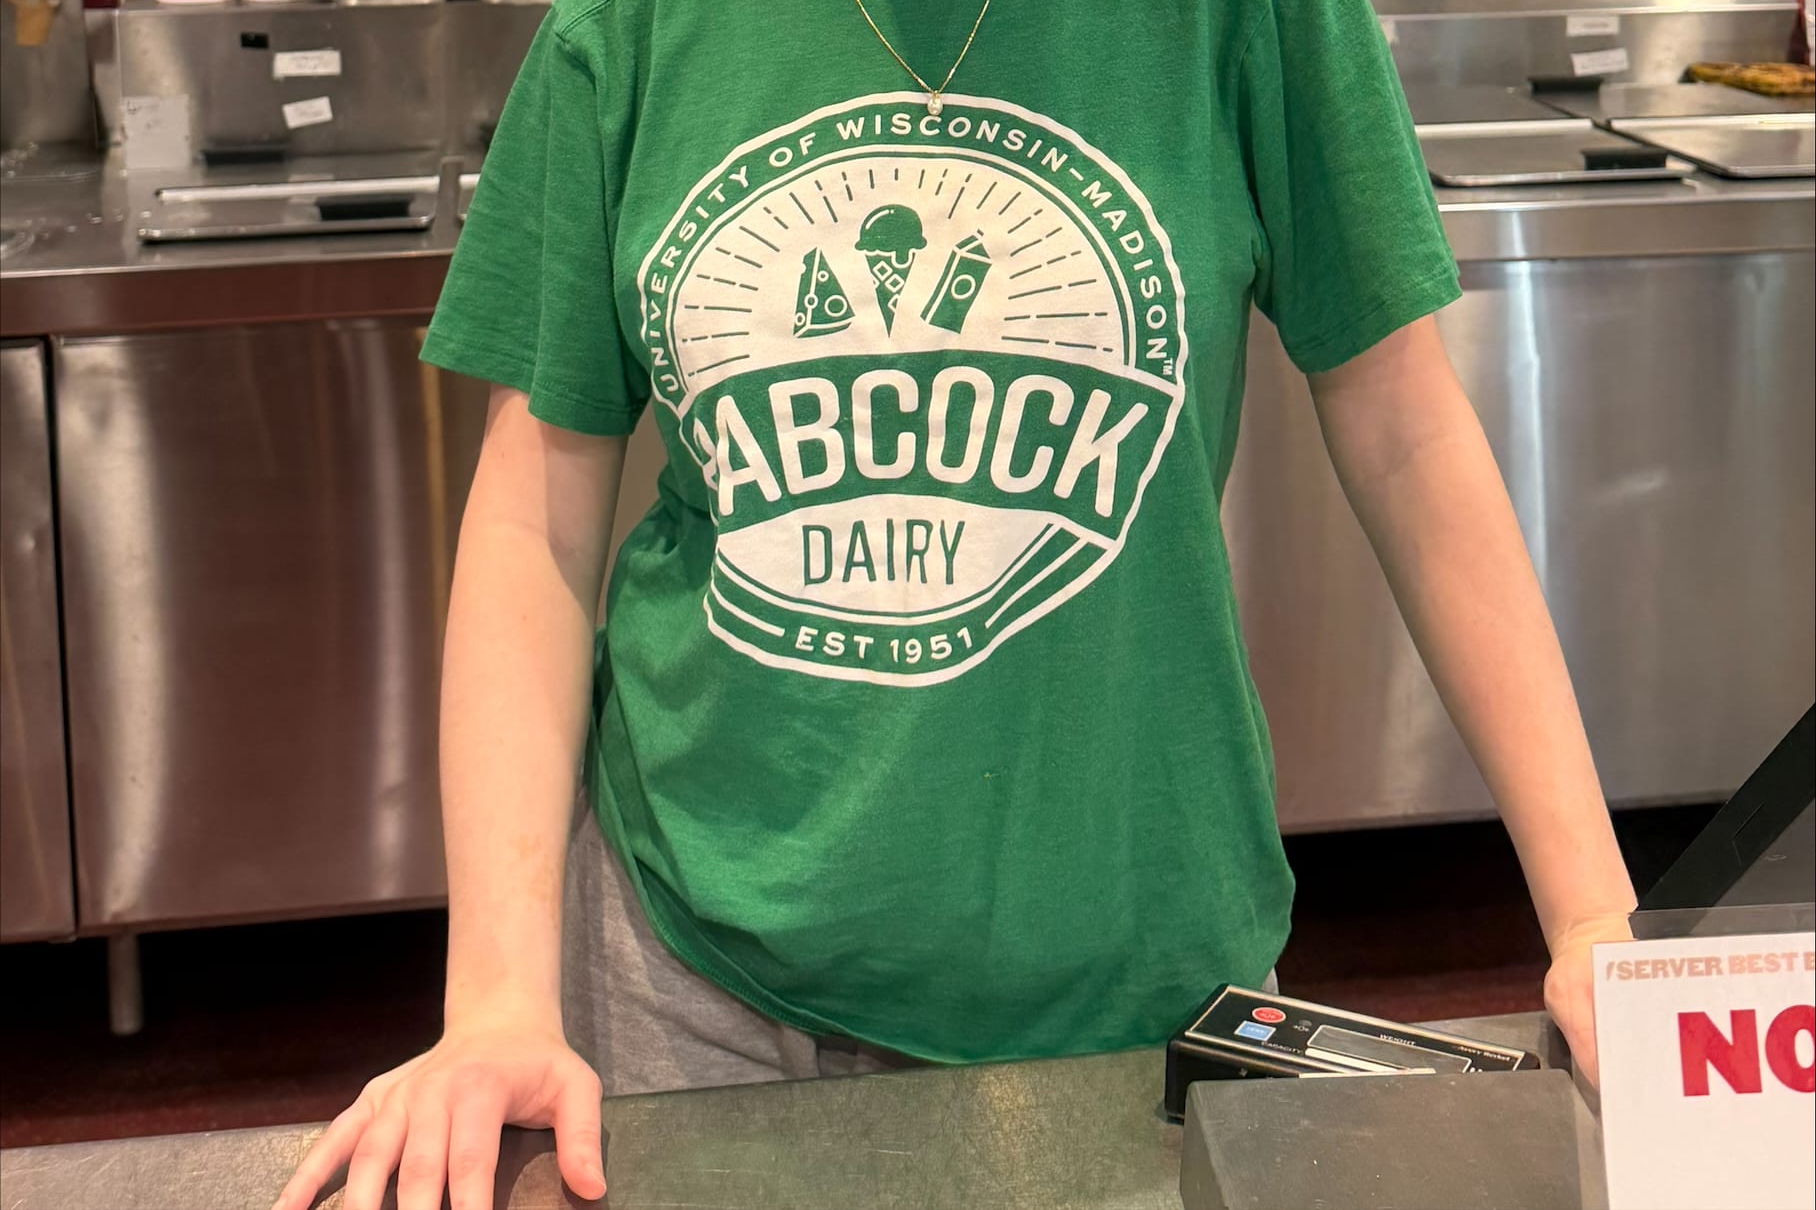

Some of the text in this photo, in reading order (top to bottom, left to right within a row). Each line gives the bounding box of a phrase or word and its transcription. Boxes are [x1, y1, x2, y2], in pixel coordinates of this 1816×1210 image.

[648, 164, 750, 393] UNIVERSITY
[767, 131, 817, 169] OF
[801, 518, 967, 587] DAIRY
[794, 626, 975, 665] EST 1951
[1728, 951, 1798, 975] BEST
[1677, 1004, 1815, 1097] NO
